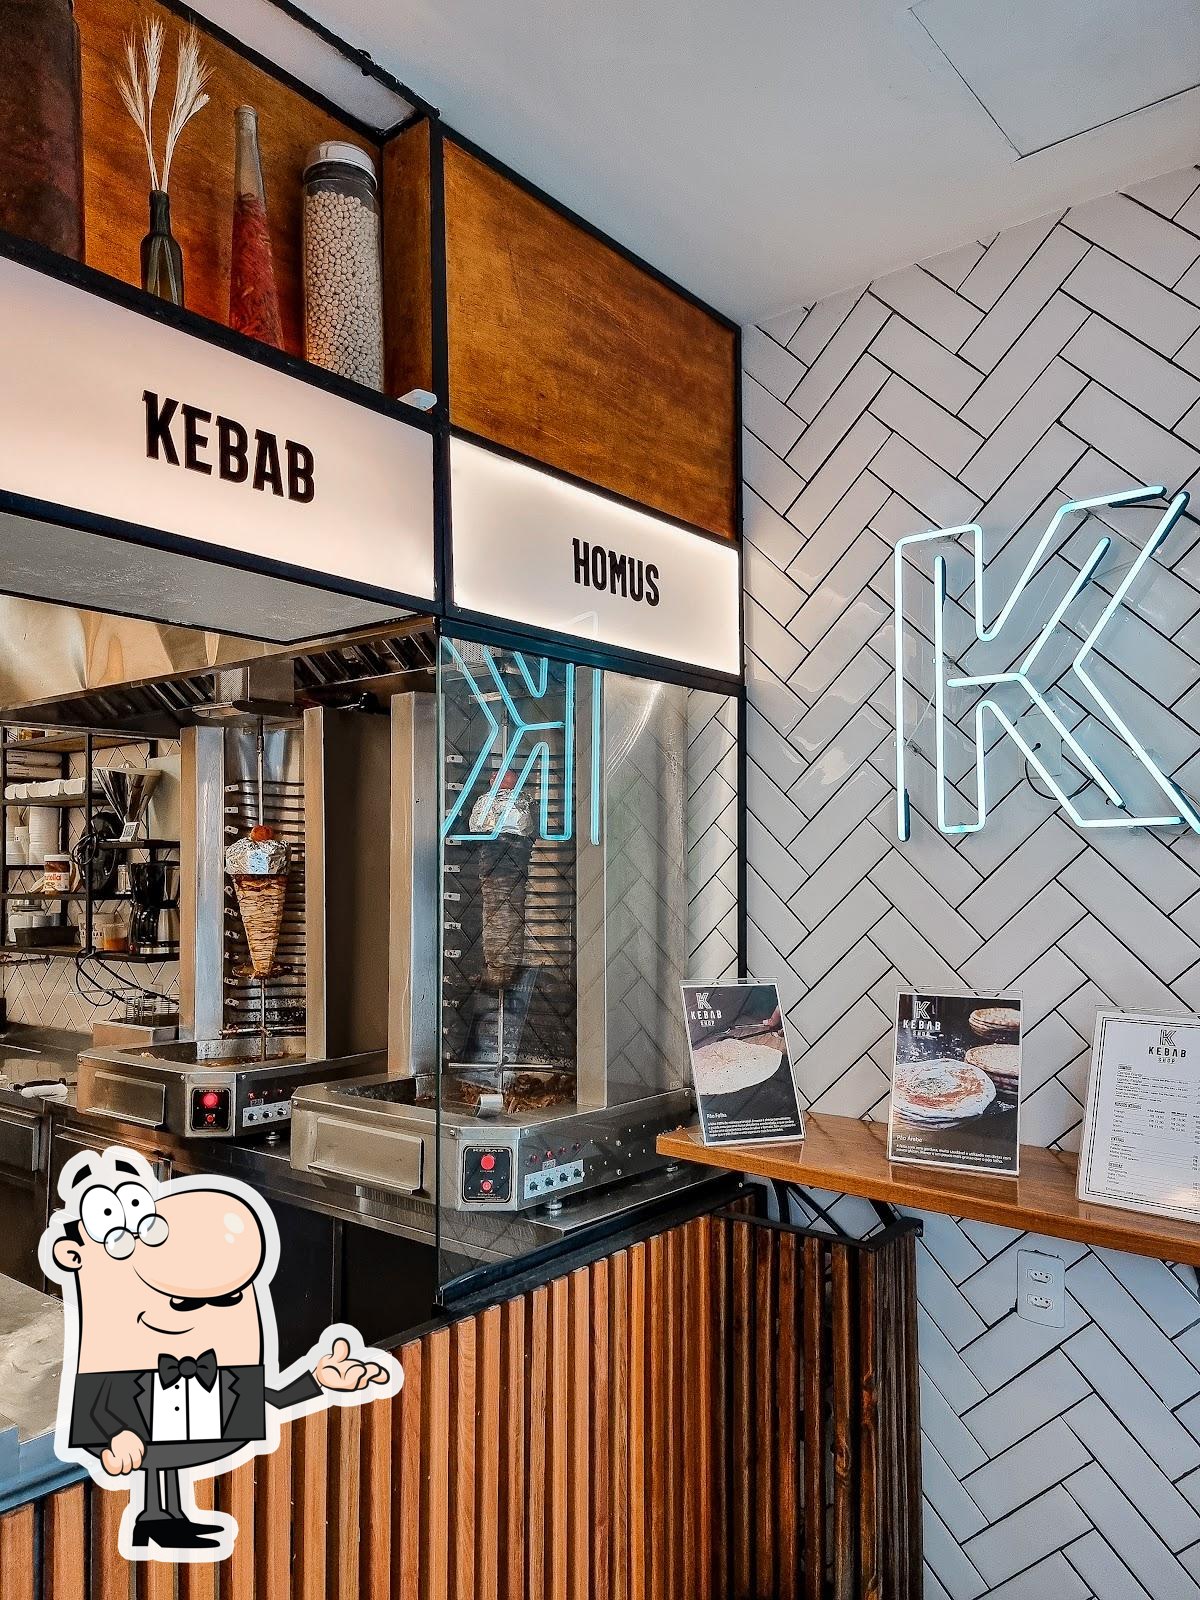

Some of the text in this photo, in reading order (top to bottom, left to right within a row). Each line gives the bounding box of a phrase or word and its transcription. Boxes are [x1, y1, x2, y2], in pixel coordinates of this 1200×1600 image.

[142, 389, 315, 504] KEBAB
[572, 537, 660, 607] HOMUS
[894, 485, 1200, 843] K
[690, 1010, 722, 1020] KEBAB
[914, 1000, 931, 1020] K
[902, 1019, 941, 1031] KEBAB
[1159, 1029, 1177, 1047] K
[1148, 1046, 1187, 1058] KEBAB
